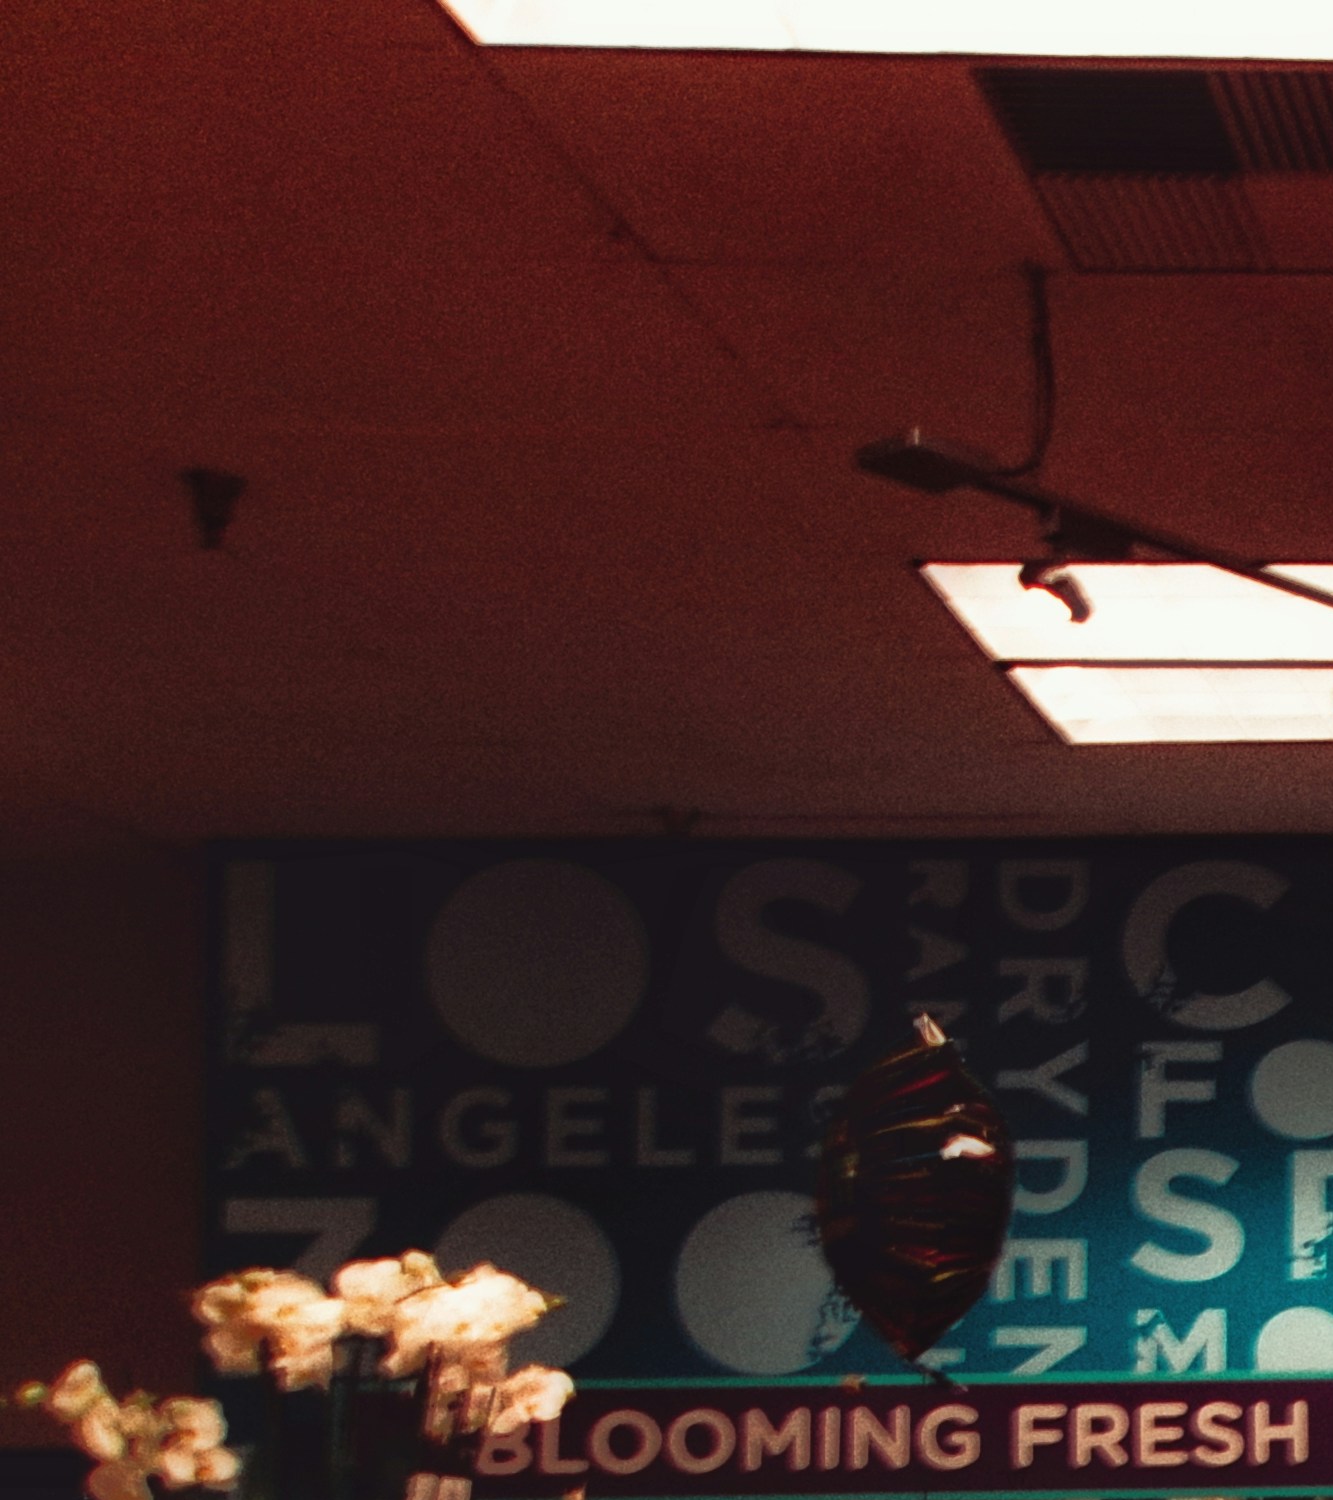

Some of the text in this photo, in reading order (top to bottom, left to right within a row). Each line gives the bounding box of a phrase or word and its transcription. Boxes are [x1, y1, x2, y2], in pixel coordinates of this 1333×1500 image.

[222, 858, 872, 1067] LOS
[995, 858, 1091, 1377] DRYDEN
[474, 1398, 1310, 1477] BLOOMING FRESH
